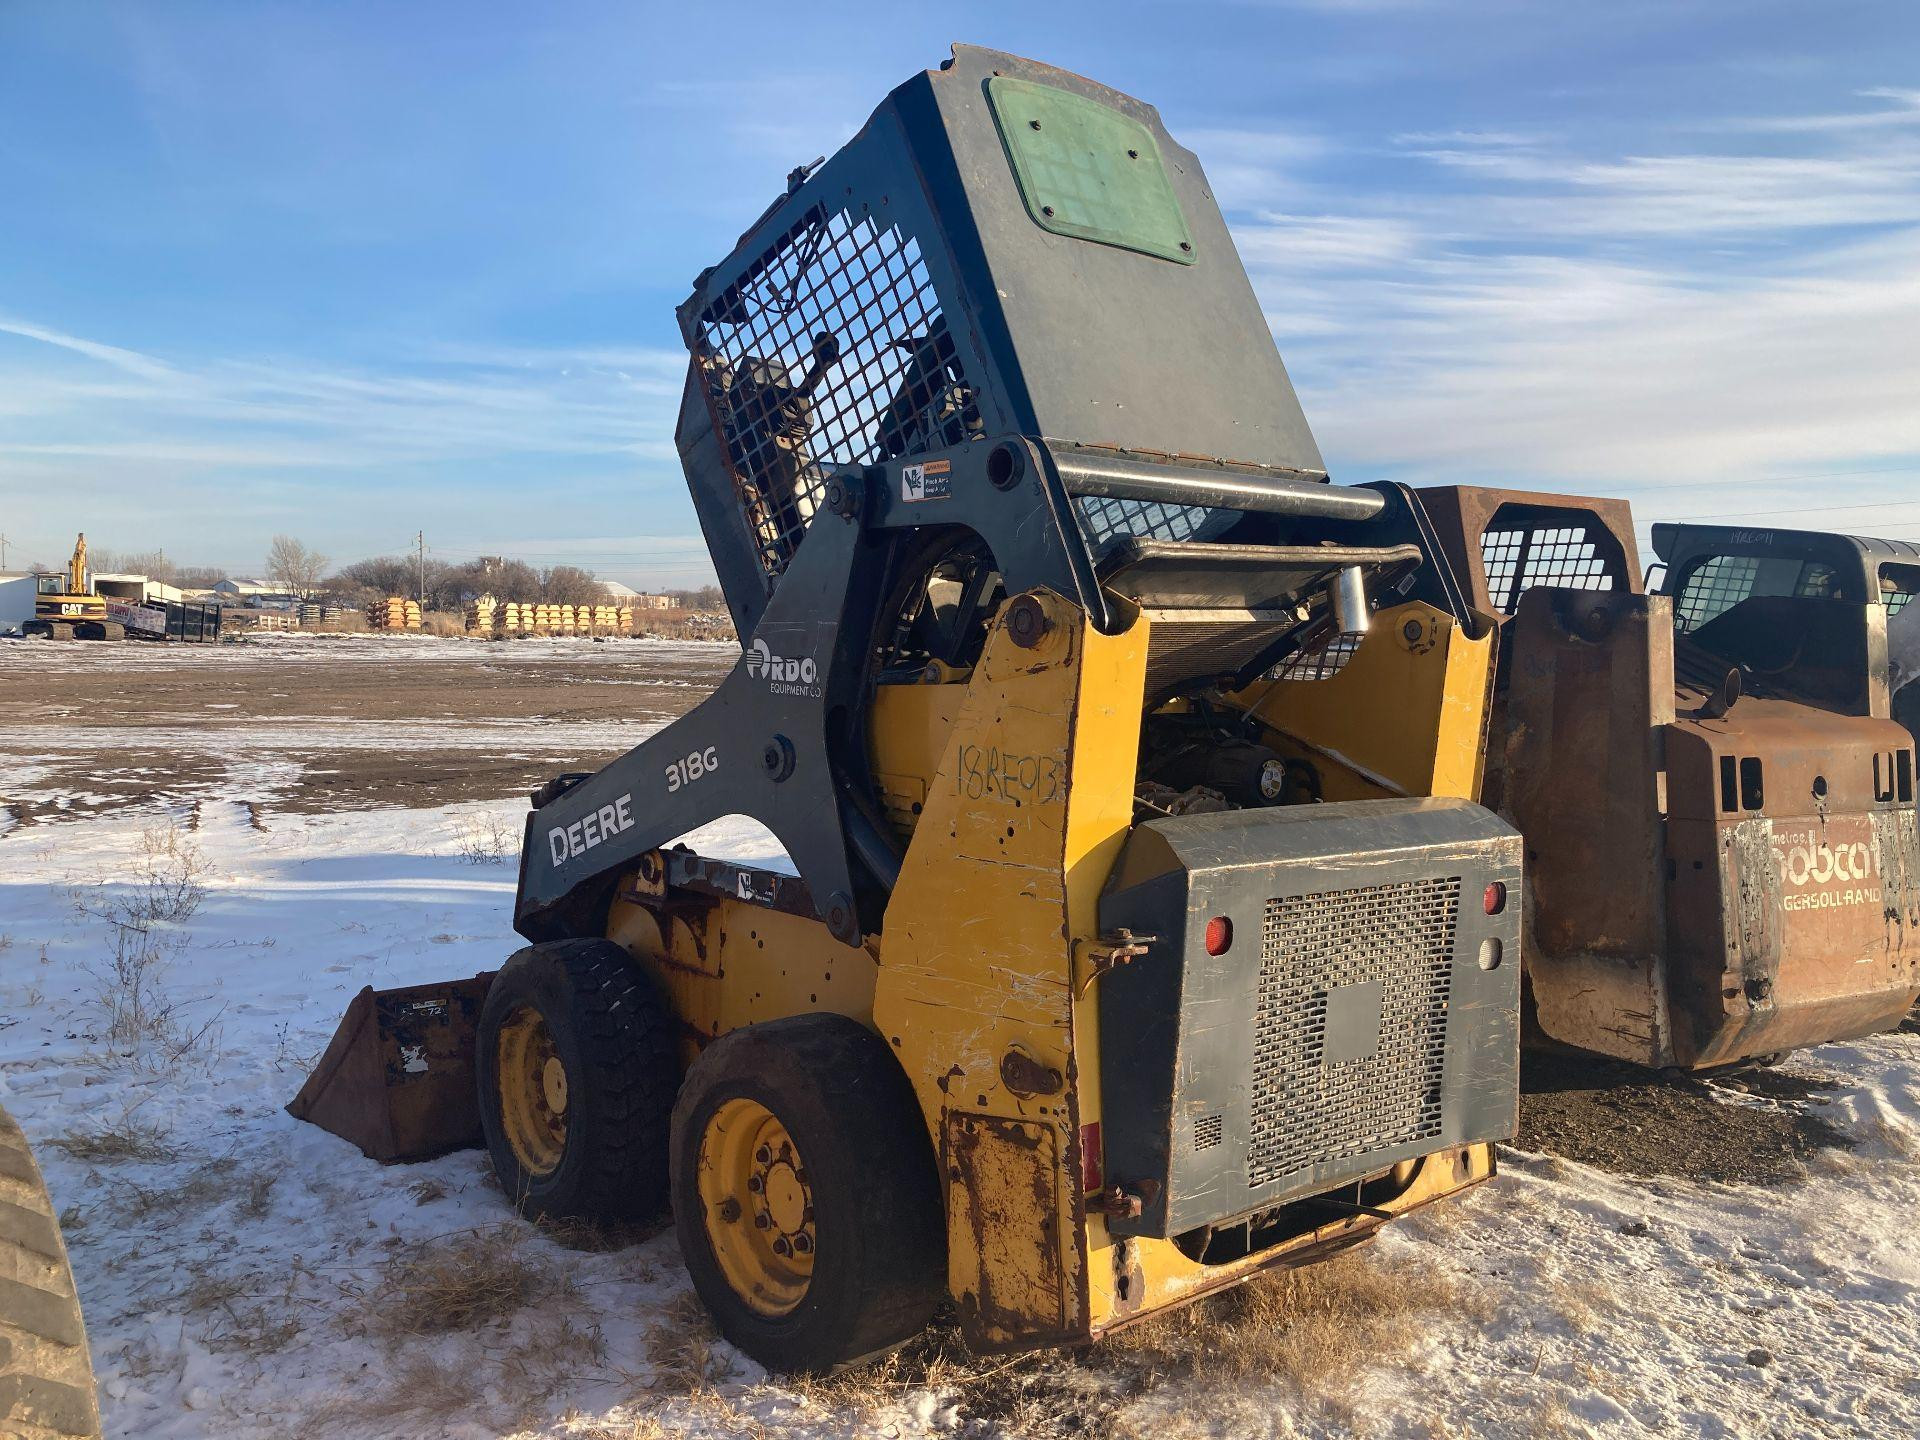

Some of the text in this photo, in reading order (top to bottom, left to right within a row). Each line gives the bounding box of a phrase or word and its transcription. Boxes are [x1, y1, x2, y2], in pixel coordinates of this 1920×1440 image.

[61, 603, 84, 616] CAT
[770, 682, 809, 697] EQUIPMENT
[665, 745, 719, 793] 318G
[548, 792, 636, 868] DEERE
